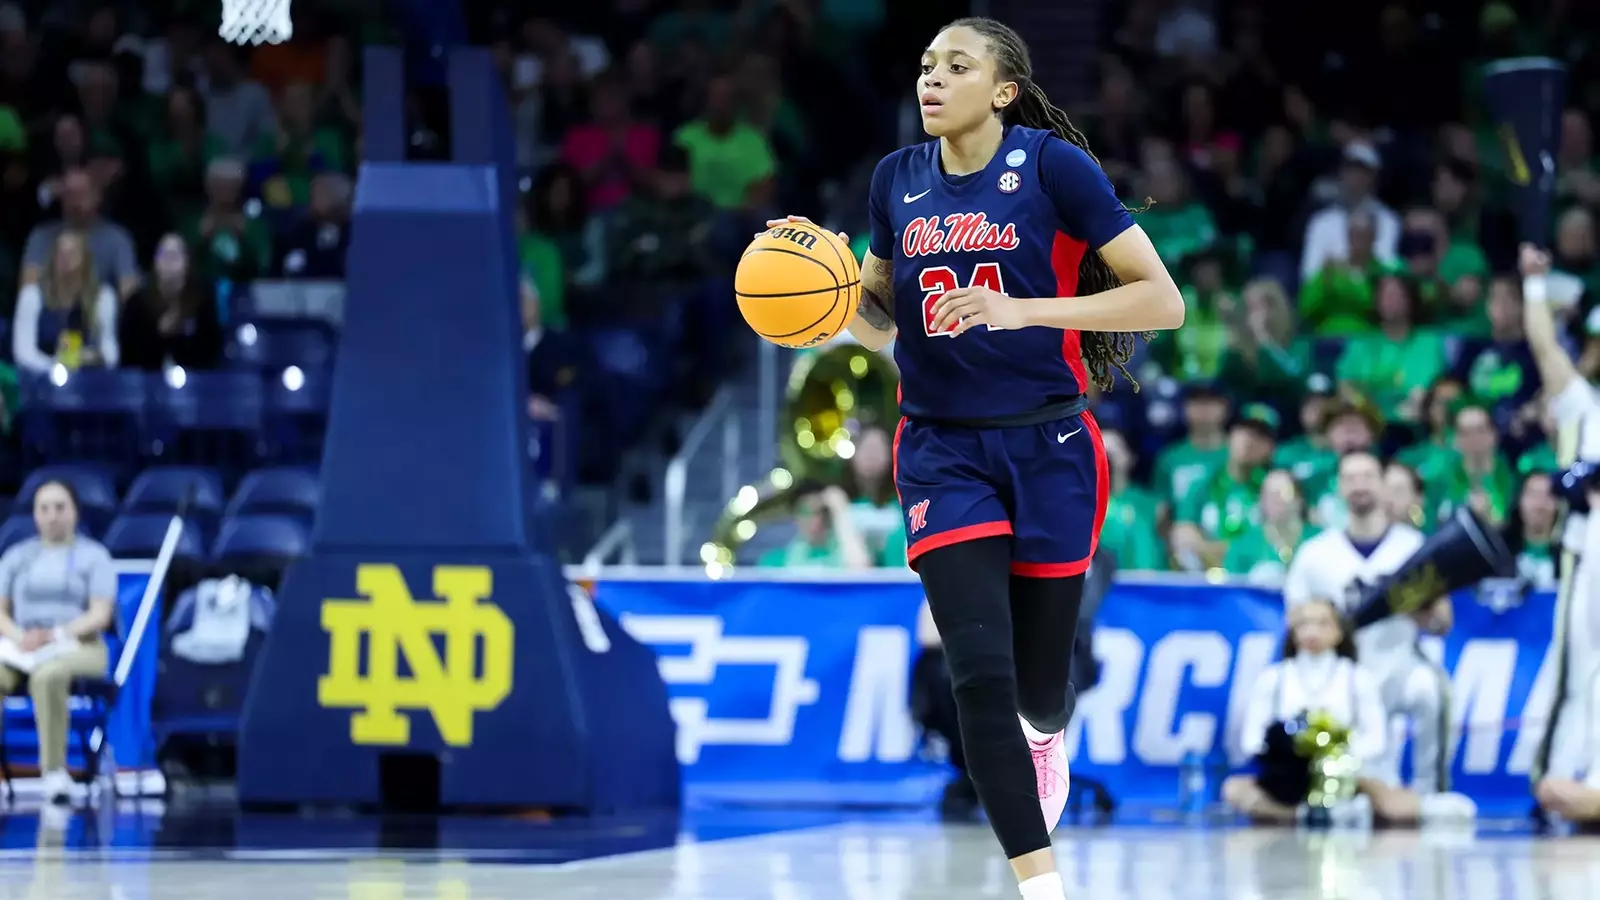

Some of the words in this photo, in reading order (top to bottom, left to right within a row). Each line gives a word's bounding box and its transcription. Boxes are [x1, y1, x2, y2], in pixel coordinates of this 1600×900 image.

[999, 172, 1019, 191] SEC
[903, 216, 944, 257] Ole
[943, 212, 1020, 252] Miss
[908, 499, 930, 534] M
